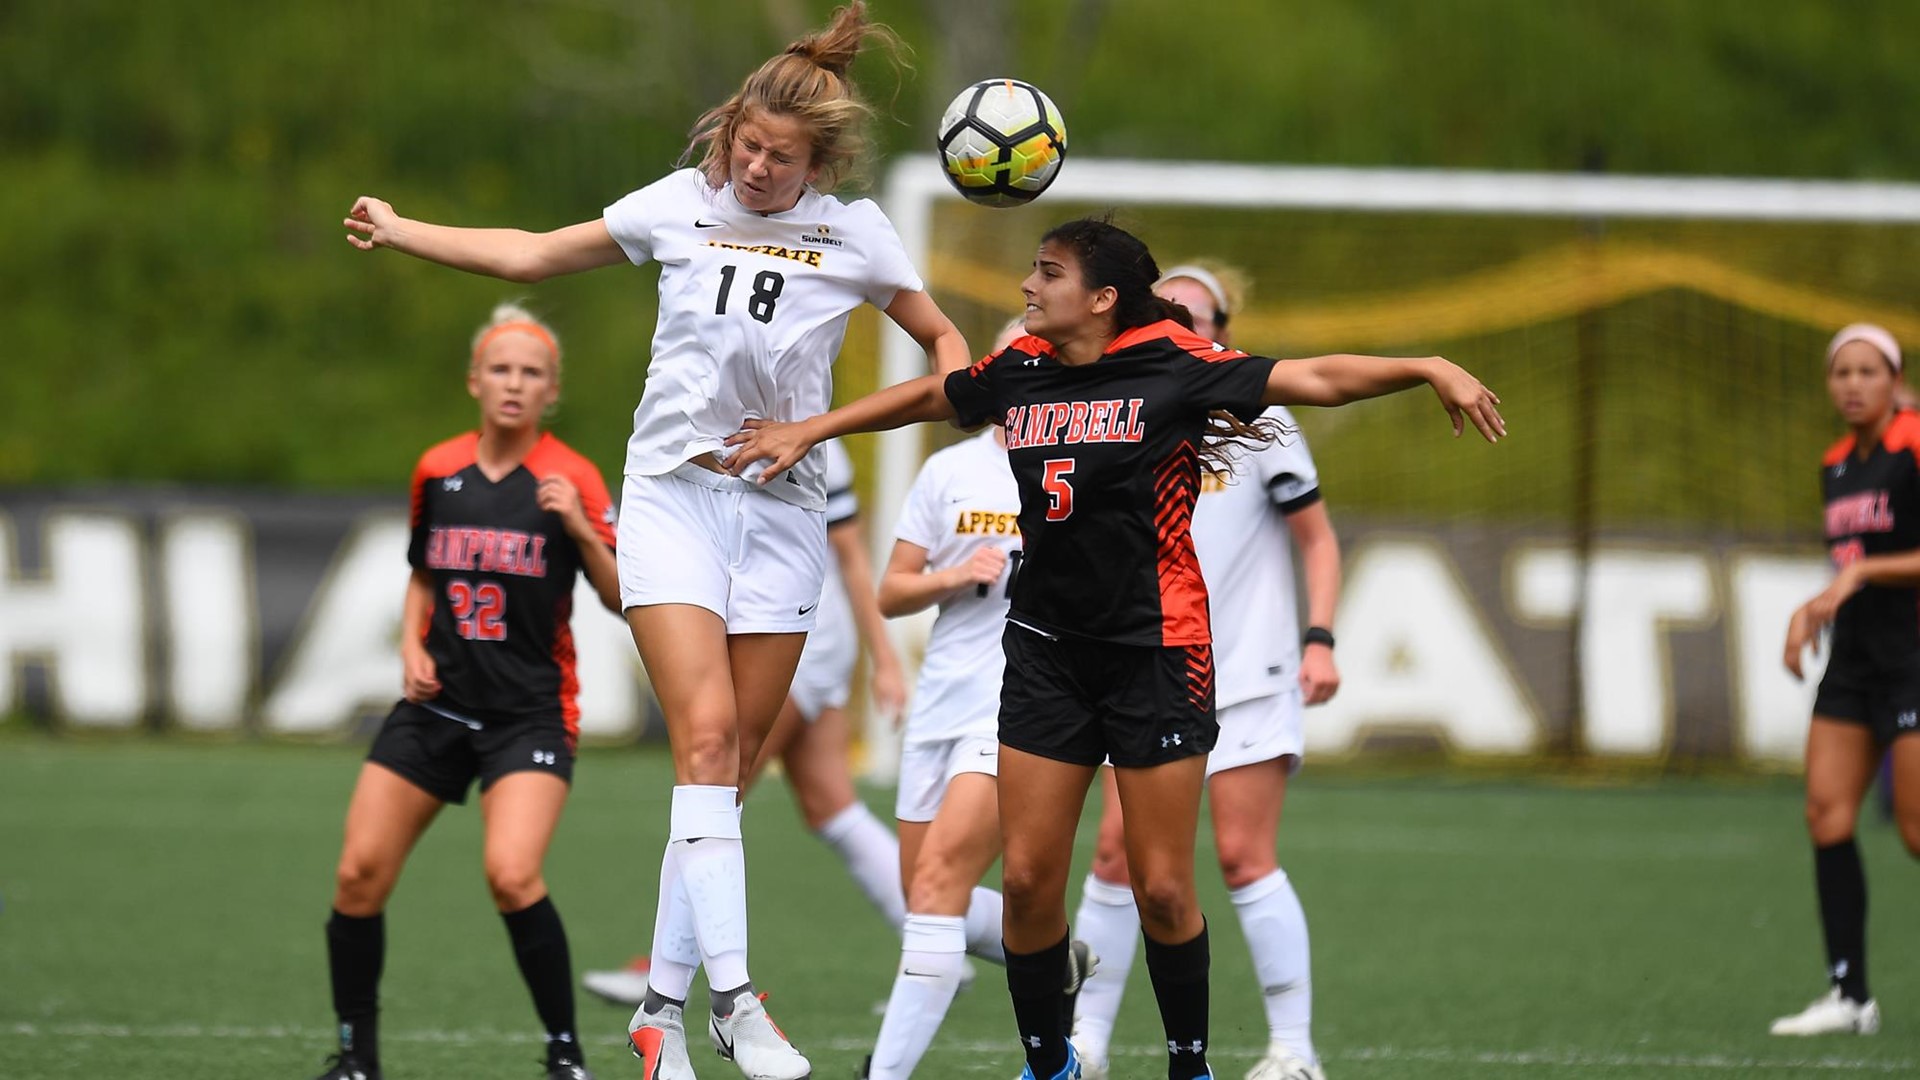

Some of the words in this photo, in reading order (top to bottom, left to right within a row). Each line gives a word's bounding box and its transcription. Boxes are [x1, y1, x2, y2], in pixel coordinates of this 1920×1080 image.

[801, 234, 822, 244] SUN
[822, 237, 843, 247] BELT
[715, 265, 785, 324] 18
[1041, 457, 1076, 522] 5
[446, 580, 507, 641] 22
